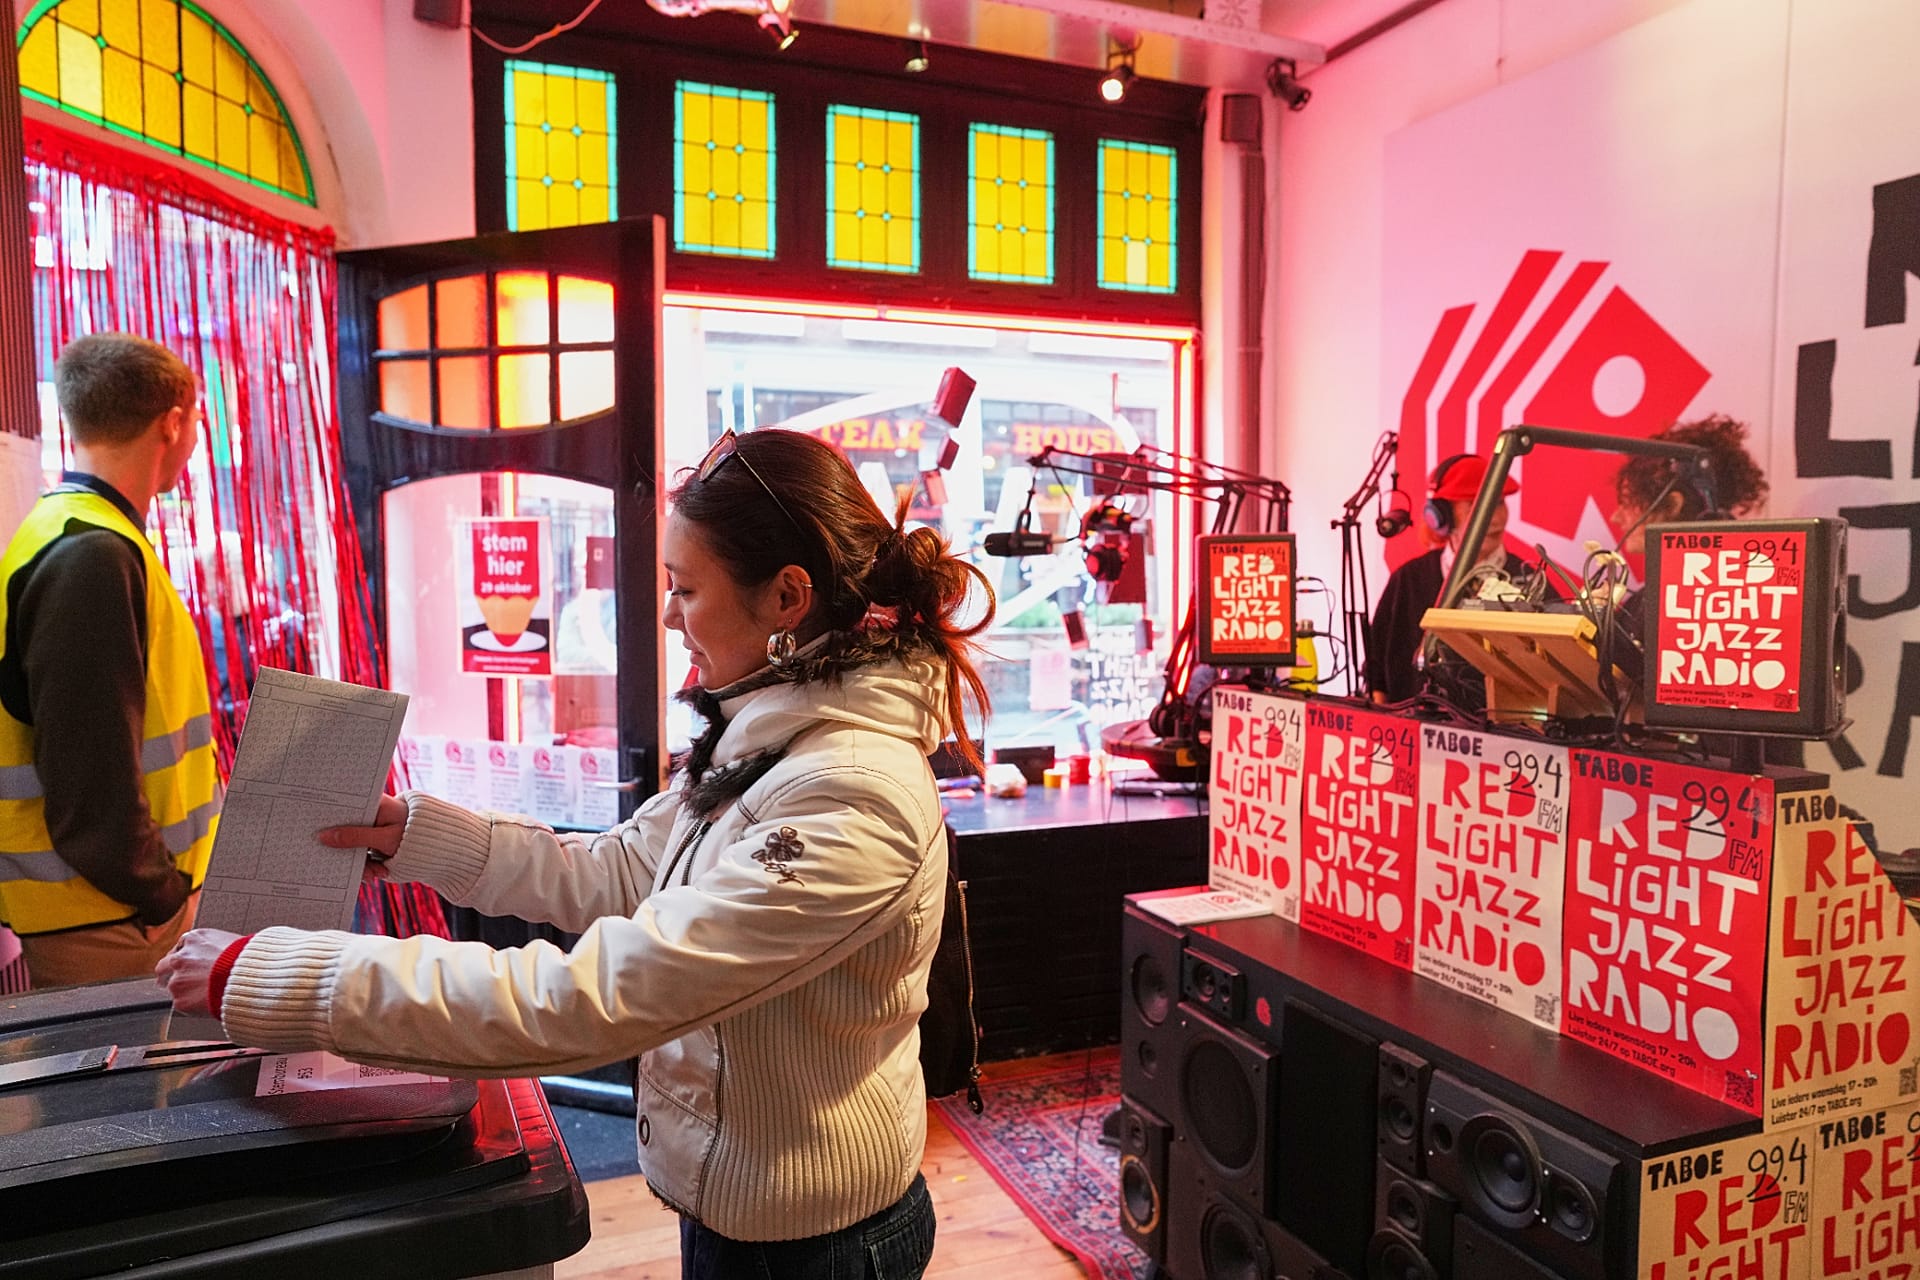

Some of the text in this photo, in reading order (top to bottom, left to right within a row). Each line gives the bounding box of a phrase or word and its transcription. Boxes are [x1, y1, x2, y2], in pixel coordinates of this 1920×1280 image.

[819, 418, 926, 450] TEAK
[482, 535, 527, 552] stem
[1212, 546, 1245, 554] TABOE
[1664, 535, 1723, 549] TABOE
[1743, 537, 1798, 565] 99.4
[487, 555, 525, 576] hier
[1223, 554, 1275, 578] RED
[1682, 550, 1775, 586] RED
[1221, 599, 1281, 618] JAZZ
[1676, 622, 1783, 651] JAZZ
[1216, 691, 1253, 712] TABOE
[1228, 715, 1284, 760] RED
[1264, 706, 1301, 742] 99.4
[1309, 709, 1353, 732] TABOE
[1321, 733, 1394, 787] RED
[1368, 726, 1415, 766] 99.4
[1423, 729, 1483, 757] TABOE
[1443, 759, 1536, 818] RED
[1503, 750, 1563, 798] 99.4
[1574, 752, 1654, 788] TABOE
[1222, 798, 1287, 843] JAZZ
[1538, 798, 1563, 834] FM
[1599, 787, 1727, 862] RED
[1682, 781, 1761, 840] 99.4
[1781, 795, 1842, 825] TABO
[1315, 825, 1400, 881] JAZZ
[1728, 838, 1764, 881] FM
[1805, 823, 1886, 892] RE
[1436, 861, 1541, 928] JAZZ
[1588, 908, 1733, 993] JAZZ
[1794, 955, 1906, 1017] JAZZ
[1820, 1111, 1886, 1150] TABOE
[1647, 1150, 1724, 1192] TABOE
[1746, 1136, 1807, 1200] 99.4
[1674, 1173, 1782, 1257] RED
[1783, 1190, 1809, 1224] FM
